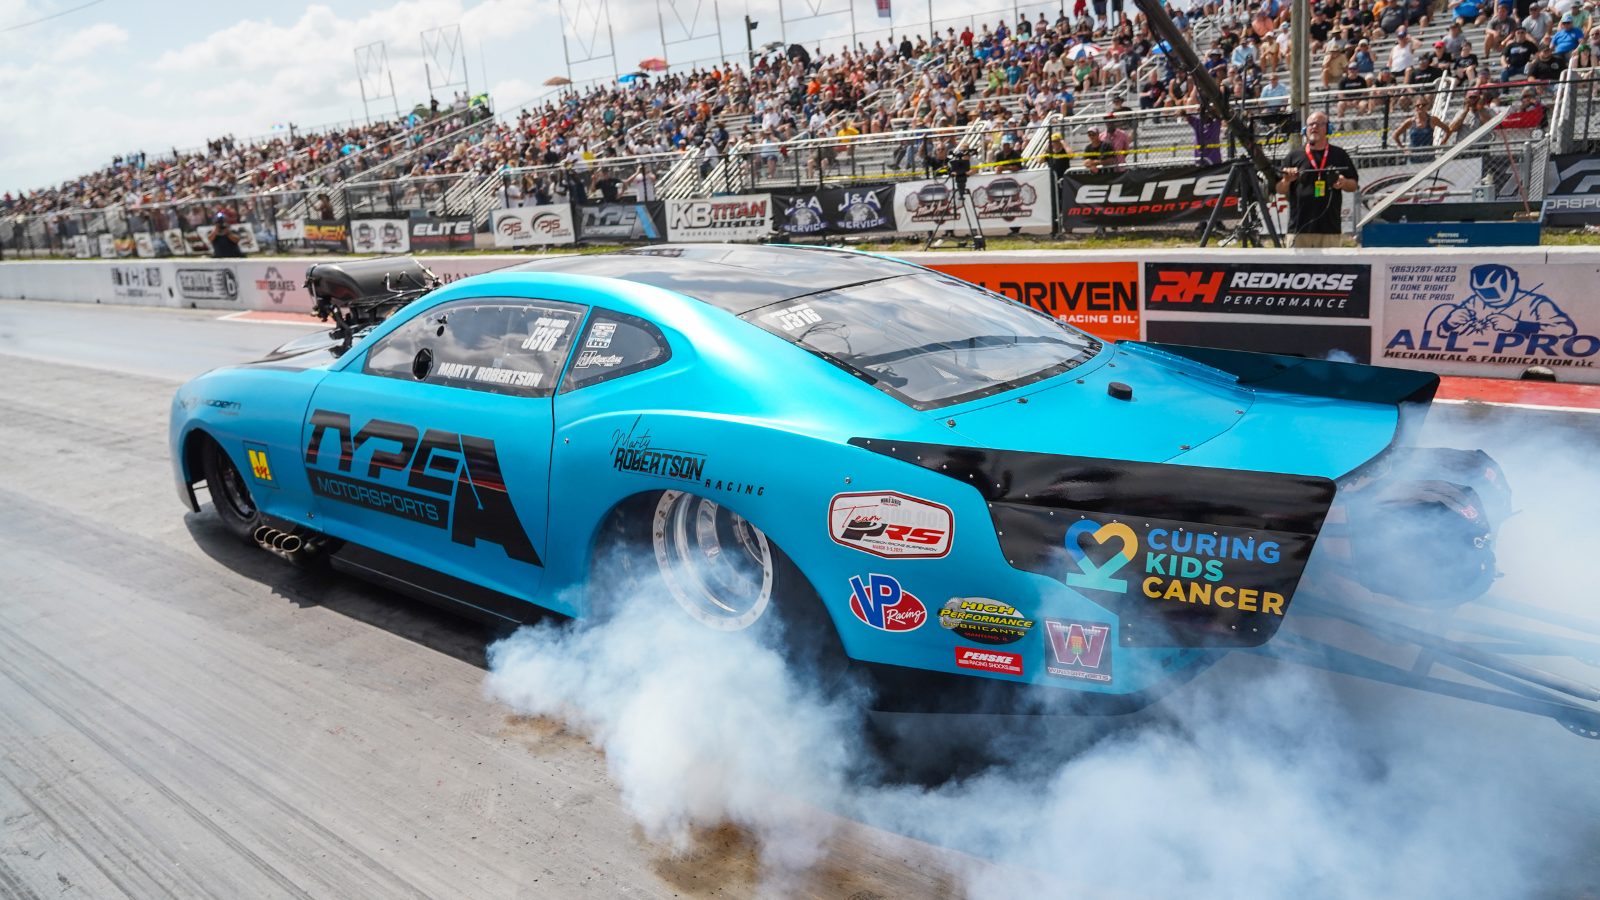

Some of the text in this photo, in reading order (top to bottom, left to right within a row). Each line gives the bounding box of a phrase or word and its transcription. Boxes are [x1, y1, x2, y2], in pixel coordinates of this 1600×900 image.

[838, 190, 882, 212] J&A
[1075, 174, 1230, 204] ELITE
[671, 200, 767, 230] KB TITAN
[1067, 200, 1203, 216] MOTORSPORTS
[413, 221, 472, 236] ELITE
[784, 222, 828, 233] SERVICE
[837, 217, 886, 229] SERVICE
[1150, 271, 1226, 304] RH
[1230, 272, 1360, 291] REDHORSE
[1424, 284, 1449, 292] RIGHT
[1000, 281, 1138, 316] DRIVEN
[1223, 295, 1348, 309] PERFORMANCE
[780, 308, 823, 331] J316
[1060, 314, 1136, 324] RACING OIL
[521, 327, 564, 352] J316
[1385, 329, 1600, 358] ALL-PRO
[1383, 350, 1462, 362] MECHANICAL
[1481, 355, 1574, 367] FABRICATION
[437, 362, 544, 388] MARTY ROBERTSON
[610, 413, 651, 456] Marty
[613, 447, 706, 481] ROBERTSON
[306, 408, 544, 568] TYPE A
[317, 476, 440, 521] MOTORSPORTS
[705, 478, 765, 496] RACING
[833, 504, 882, 529] Team
[1147, 528, 1280, 564] CURING
[1145, 551, 1224, 582] KIDS
[849, 573, 902, 630] VP
[960, 601, 1015, 615] HIGH
[1142, 576, 1285, 616] CANCER
[886, 608, 921, 625] Racing
[940, 609, 1033, 628] PERFORMANCE
[963, 651, 1014, 664] PENSKE
